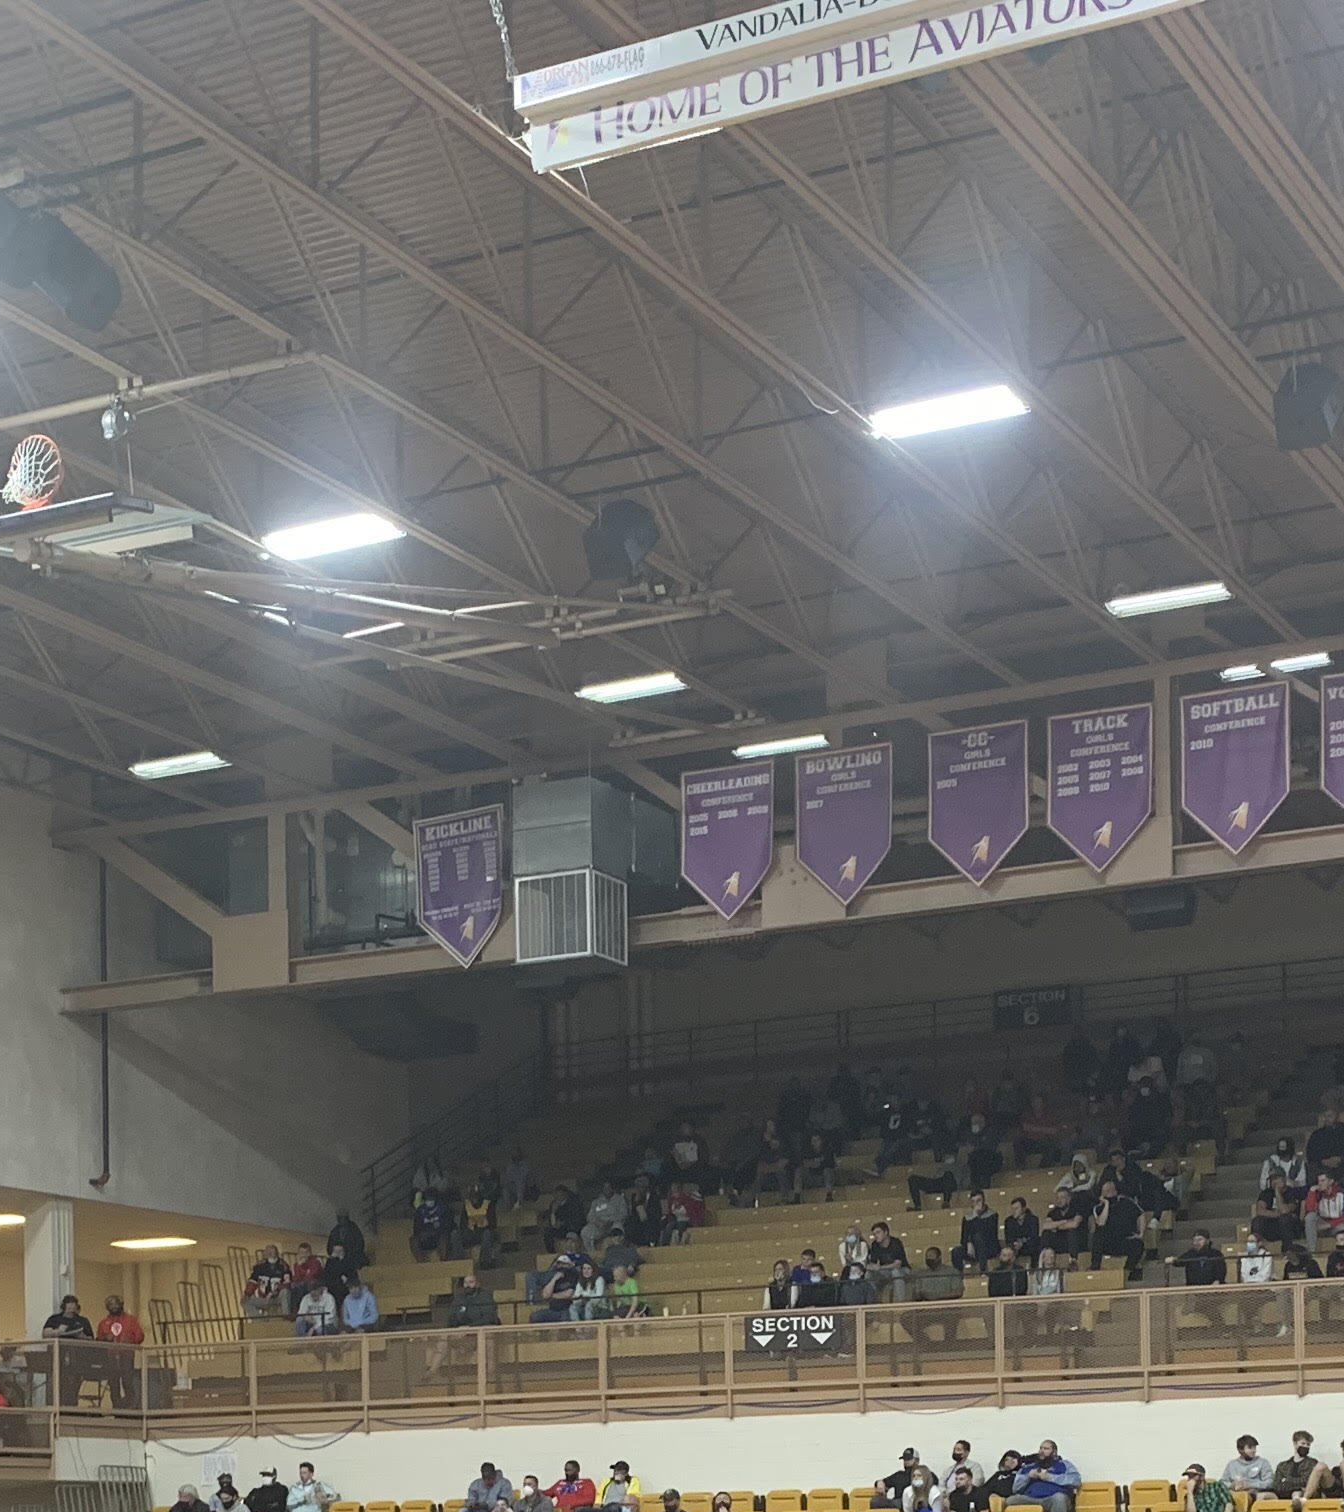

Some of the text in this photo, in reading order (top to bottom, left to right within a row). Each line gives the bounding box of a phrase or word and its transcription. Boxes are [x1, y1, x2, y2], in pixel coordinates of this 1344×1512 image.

[589, 81, 722, 144] HOME
[738, 63, 793, 106] OF
[806, 33, 892, 88] THE
[1190, 692, 1281, 720] SOFTBALL
[1071, 714, 1129, 735] TRACK
[1203, 717, 1267, 734] CONFERENCE
[963, 749, 991, 760] GIRLS
[1069, 741, 1130, 758] CONFERENCE
[805, 750, 882, 775] BOWLING
[949, 757, 1007, 774] CONFERENCE
[686, 773, 771, 796] CHEERLEADING
[425, 815, 493, 842] KICKLINE
[752, 1315, 834, 1333] SECTION
[786, 1333, 798, 1348] 2
